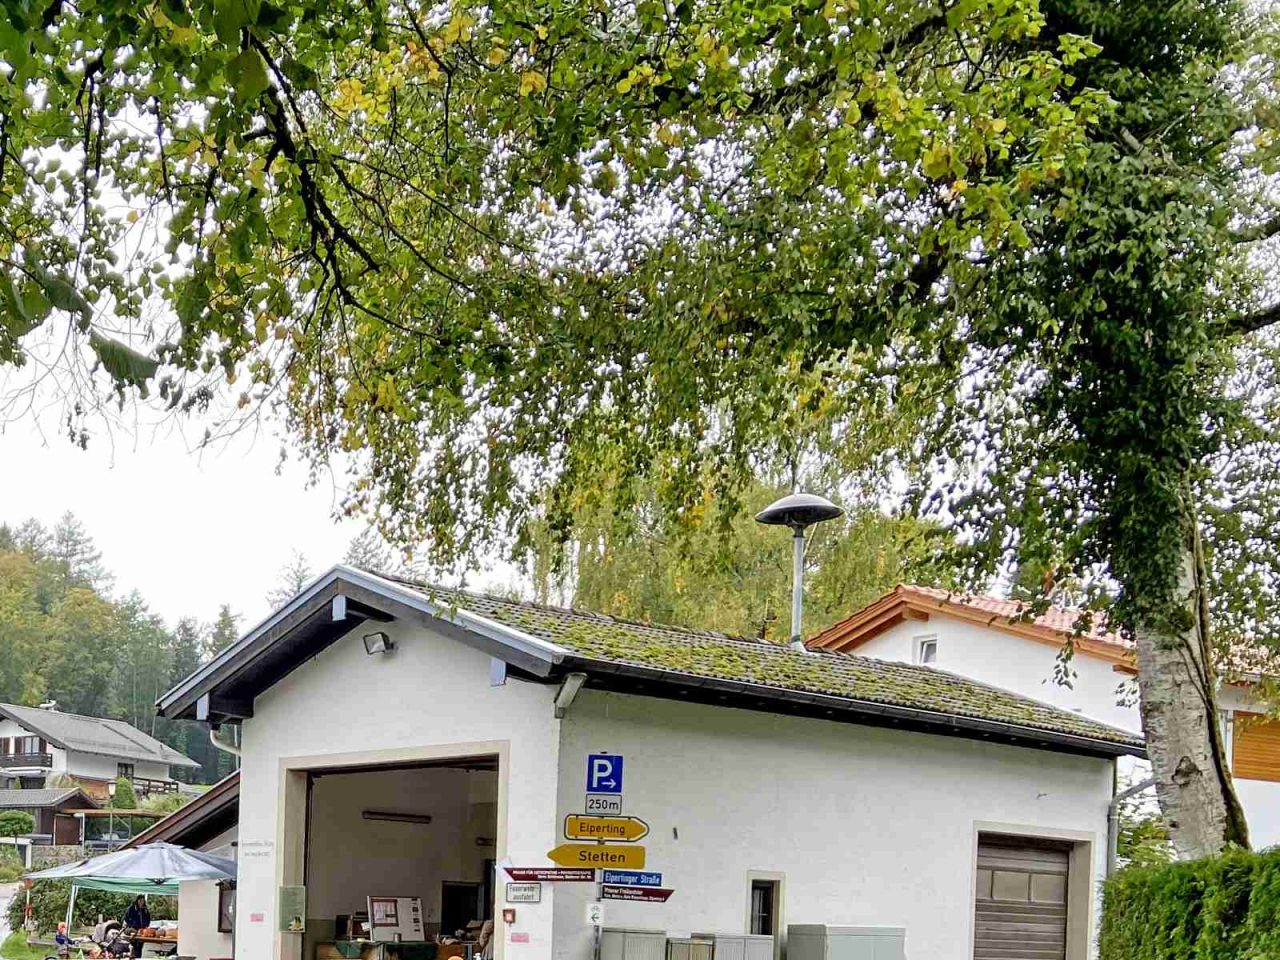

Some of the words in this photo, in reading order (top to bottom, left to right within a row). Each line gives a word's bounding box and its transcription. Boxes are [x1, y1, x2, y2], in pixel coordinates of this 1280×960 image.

[592, 759, 612, 788] P
[579, 822, 626, 836] Eiperting
[578, 850, 626, 863] Stetten
[605, 872, 638, 885] Eipertinger
[640, 874, 660, 885] Straße
